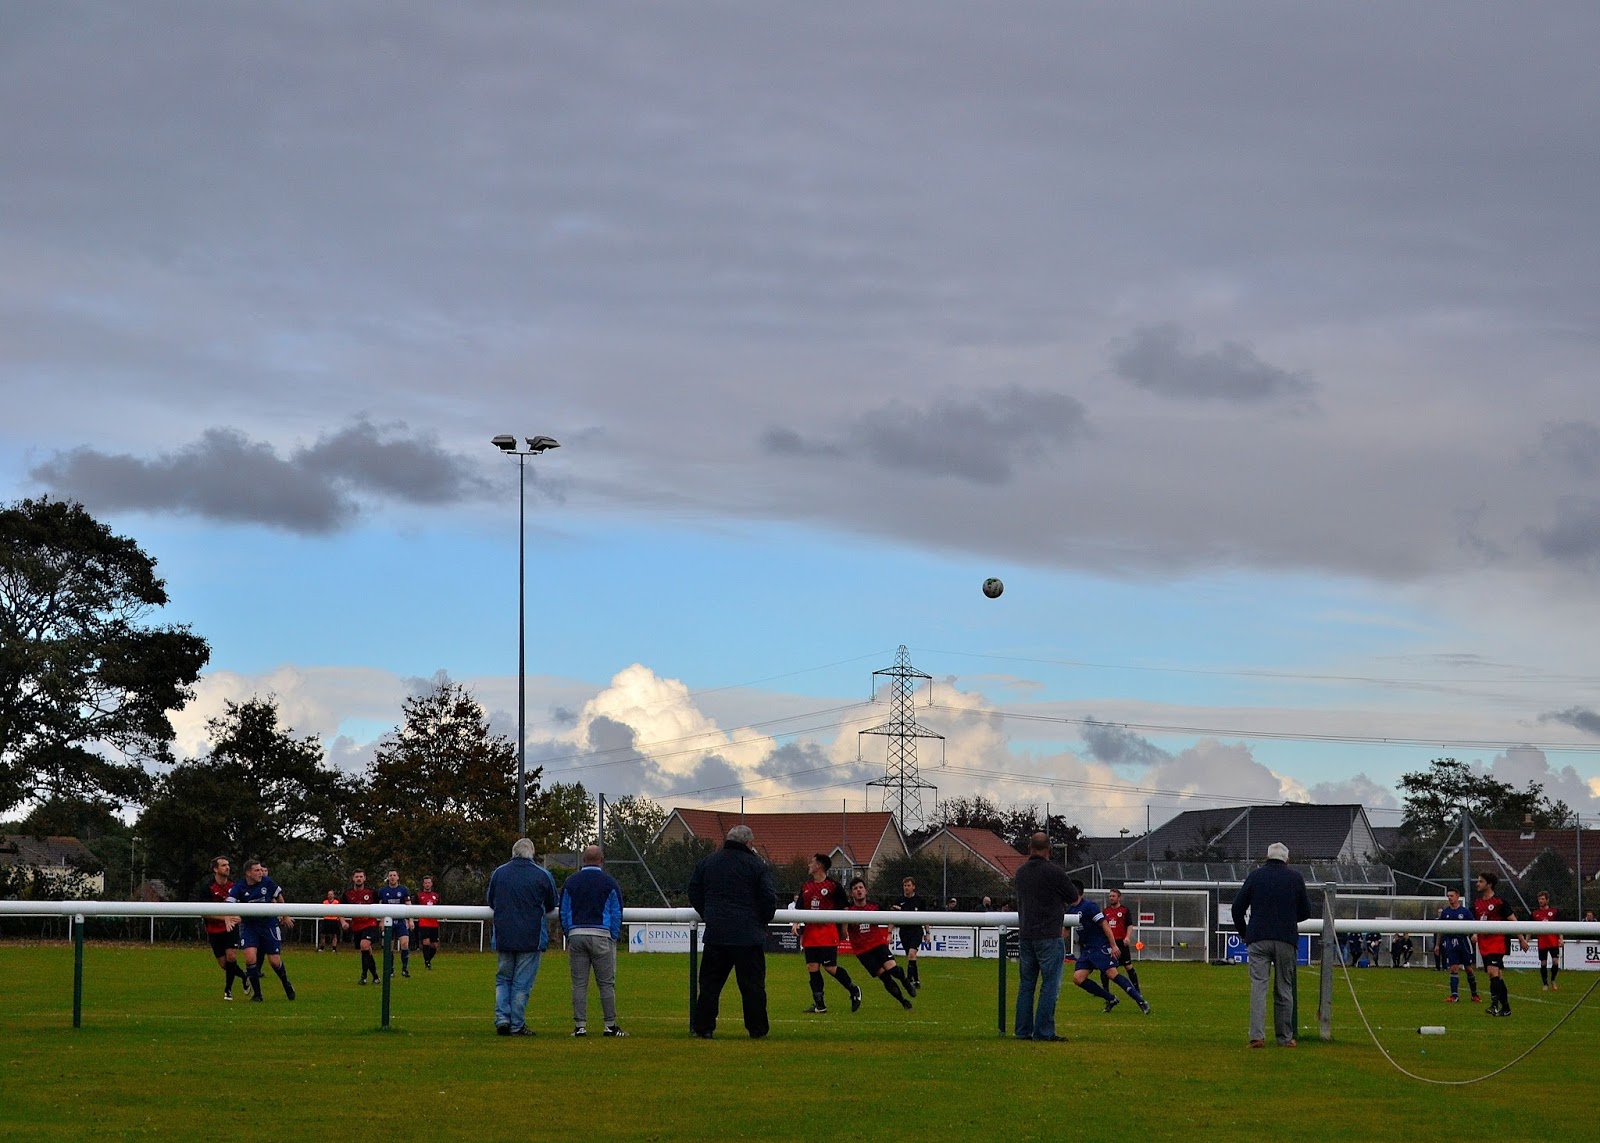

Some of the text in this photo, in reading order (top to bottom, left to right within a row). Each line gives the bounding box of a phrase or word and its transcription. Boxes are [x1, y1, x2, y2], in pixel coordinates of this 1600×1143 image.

[648, 931, 703, 939] SPINNAE
[982, 940, 998, 948] JOLLY
[1586, 953, 1600, 961] CA
